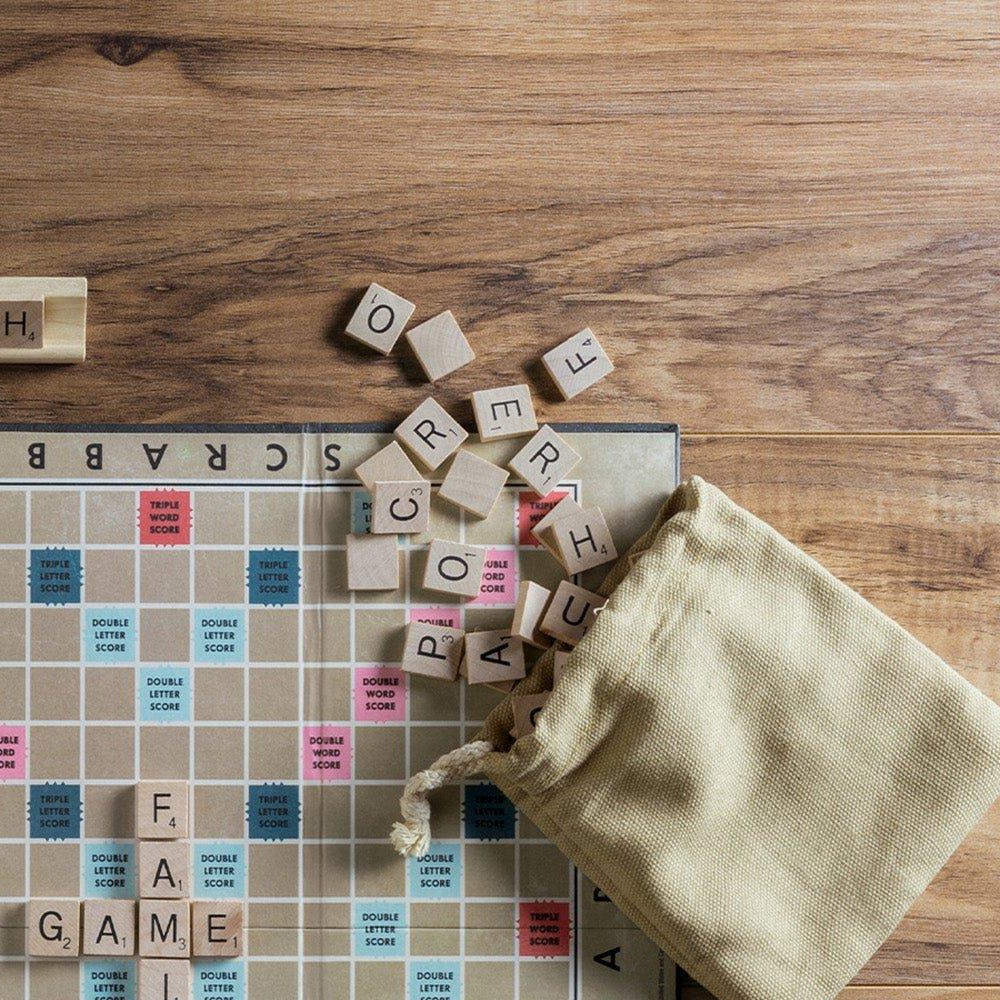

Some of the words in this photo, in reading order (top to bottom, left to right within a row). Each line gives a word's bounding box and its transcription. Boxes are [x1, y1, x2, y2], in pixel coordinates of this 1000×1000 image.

[149, 501, 180, 510] TRIPLE
[149, 513, 180, 522] WORD
[149, 525, 180, 534] SCORE
[40, 559, 70, 569] TRIPLE
[39, 572, 71, 581] LETTER
[40, 584, 71, 593] SCORE
[147, 677, 183, 687] DOUBLE
[149, 690, 180, 699] LETTER
[150, 702, 180, 711] SCORE
[309, 736, 344, 745] DOUBLE
[312, 748, 341, 757] WORD
[312, 760, 341, 770] SCORE
[201, 854, 238, 863] DOUBLE
[204, 866, 235, 875] LETTER
[204, 879, 234, 888] SCORE
[530, 912, 560, 922] TRIPLE
[37, 909, 238, 950] GAME
[529, 924, 561, 934] WORD
[530, 936, 560, 946] SCORE
[416, 971, 454, 981] DOUBLE
[419, 984, 451, 993] LETTER
